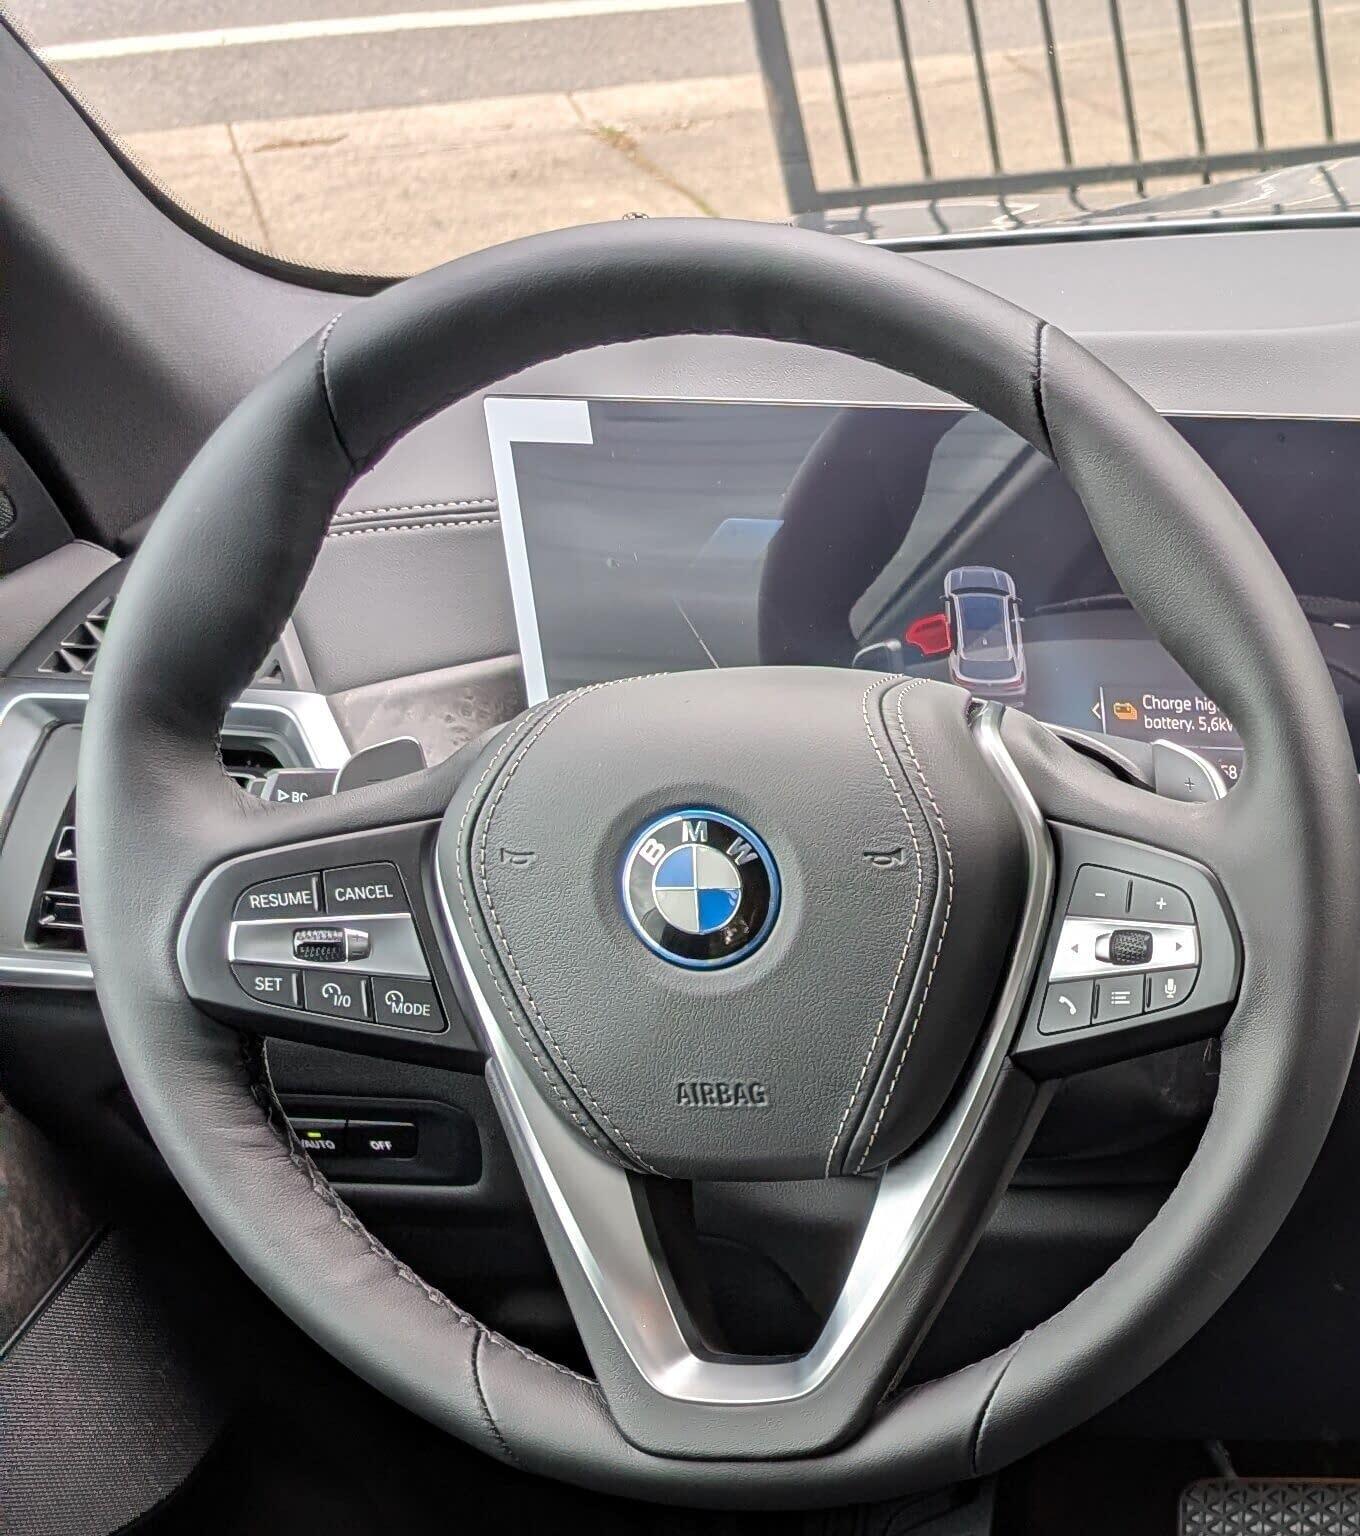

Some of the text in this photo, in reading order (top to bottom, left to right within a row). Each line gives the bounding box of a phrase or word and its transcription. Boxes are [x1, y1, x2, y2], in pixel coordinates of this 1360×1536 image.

[1142, 694, 1220, 714] Charge hig
[1144, 715, 1195, 733] battery.
[638, 820, 757, 867] BMW
[249, 890, 312, 909] RESUME
[334, 884, 393, 901] CANCEL
[254, 977, 283, 992] SET
[391, 1001, 431, 1017] MODE
[676, 1081, 768, 1107] AIRBAG
[370, 1140, 392, 1151] OFF
